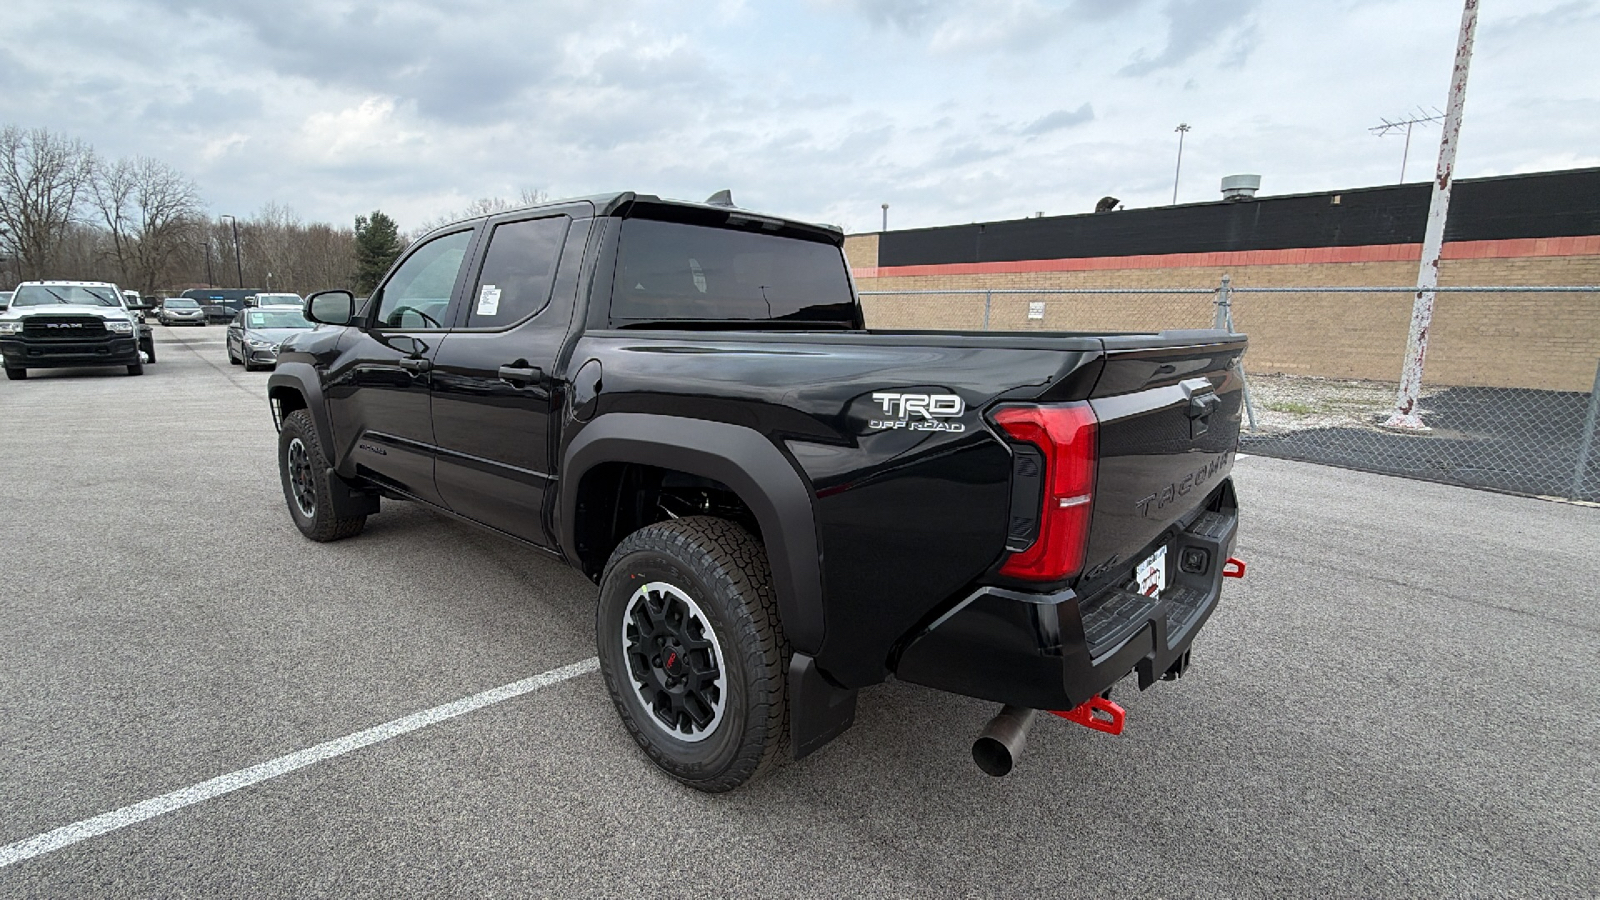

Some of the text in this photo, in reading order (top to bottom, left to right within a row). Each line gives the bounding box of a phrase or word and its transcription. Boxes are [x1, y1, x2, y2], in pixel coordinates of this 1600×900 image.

[872, 392, 966, 422] TRD
[868, 419, 966, 433] OFF ROAD
[1136, 448, 1229, 518] TACOMA
